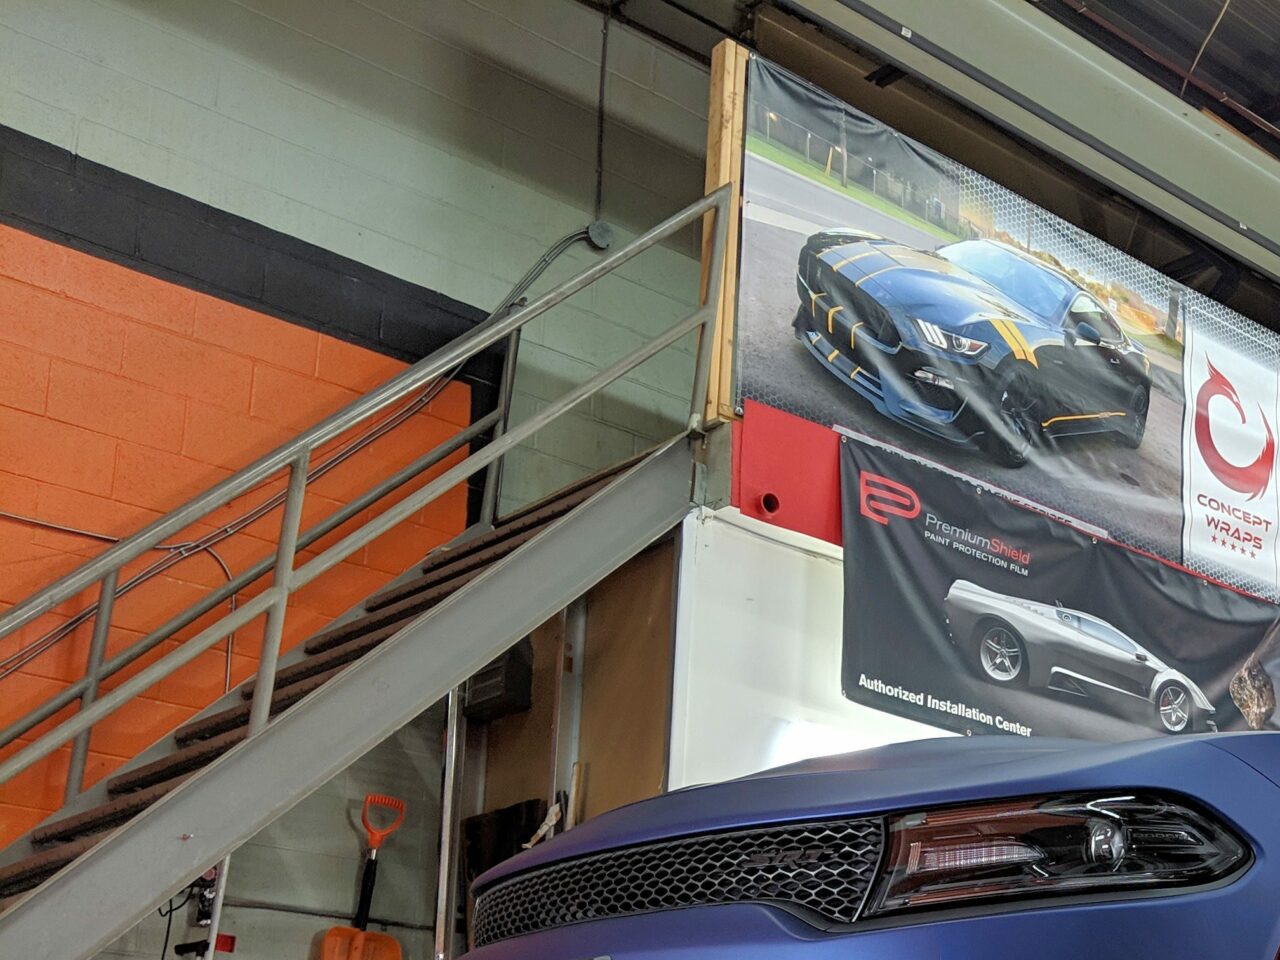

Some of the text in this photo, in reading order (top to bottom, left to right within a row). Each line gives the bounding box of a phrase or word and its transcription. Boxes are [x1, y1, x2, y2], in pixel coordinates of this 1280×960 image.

[1197, 493, 1272, 532] CONCEPT
[1205, 514, 1263, 550] WRAPS
[924, 530, 1029, 577] PAINT PROTECTION FILM
[925, 513, 1031, 565] PremiumShield
[858, 673, 1032, 738] Authorized Installation Center
